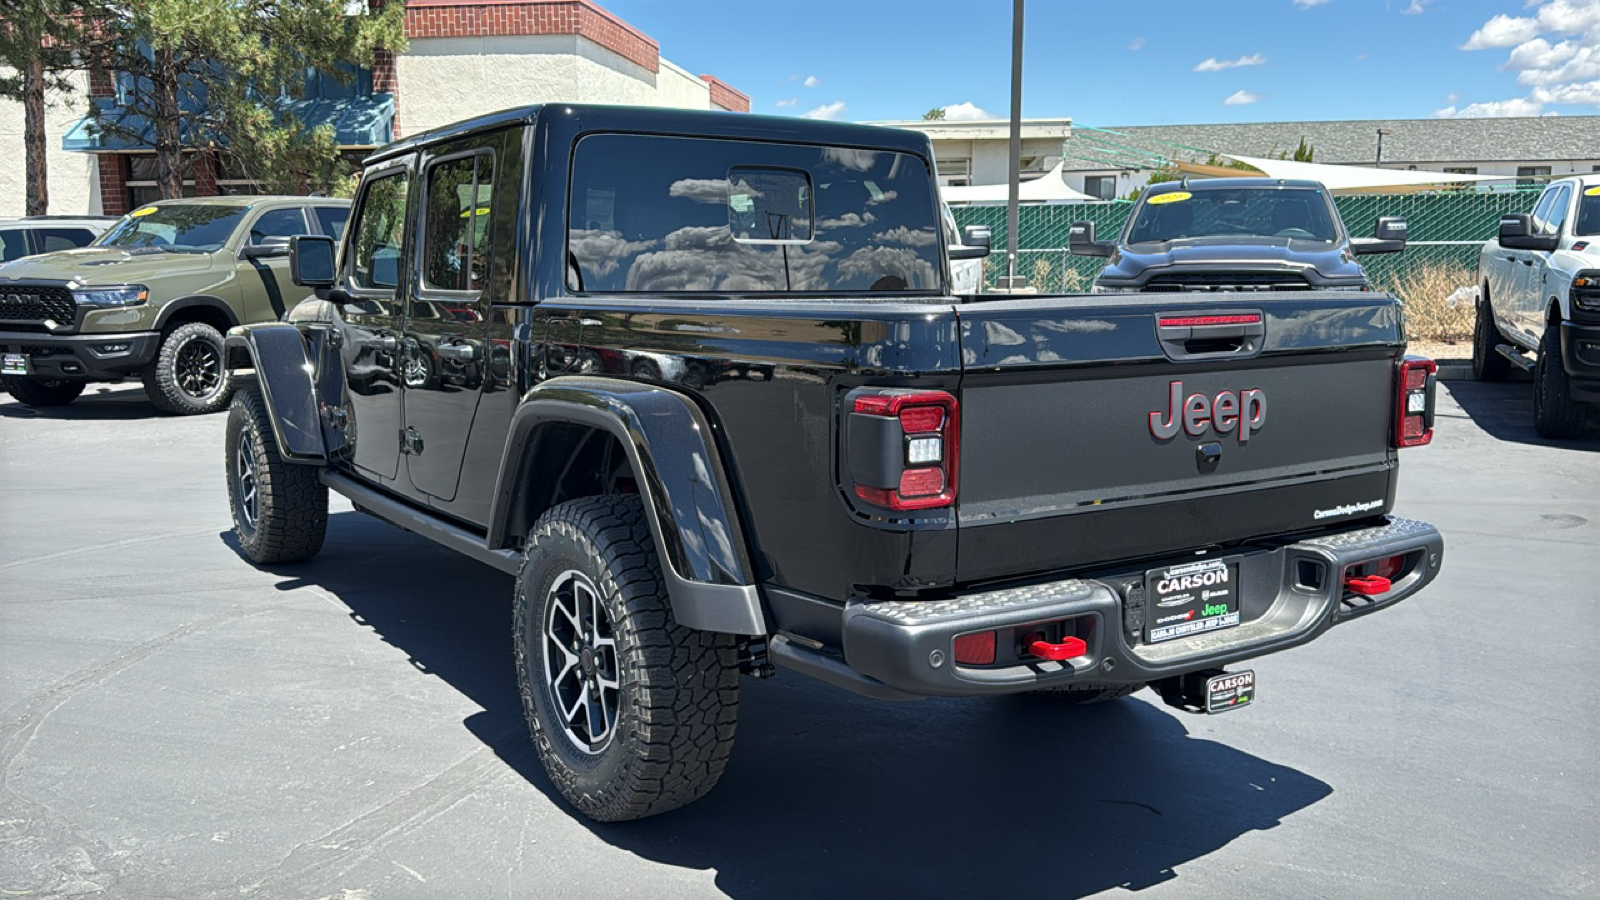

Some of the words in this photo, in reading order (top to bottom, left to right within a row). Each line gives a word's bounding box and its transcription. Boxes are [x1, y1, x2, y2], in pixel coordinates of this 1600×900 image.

[1149, 381, 1266, 441] Jeep
[1157, 568, 1229, 594] CARSON
[1201, 603, 1228, 617] Jeep
[1210, 674, 1252, 692] CARSON
